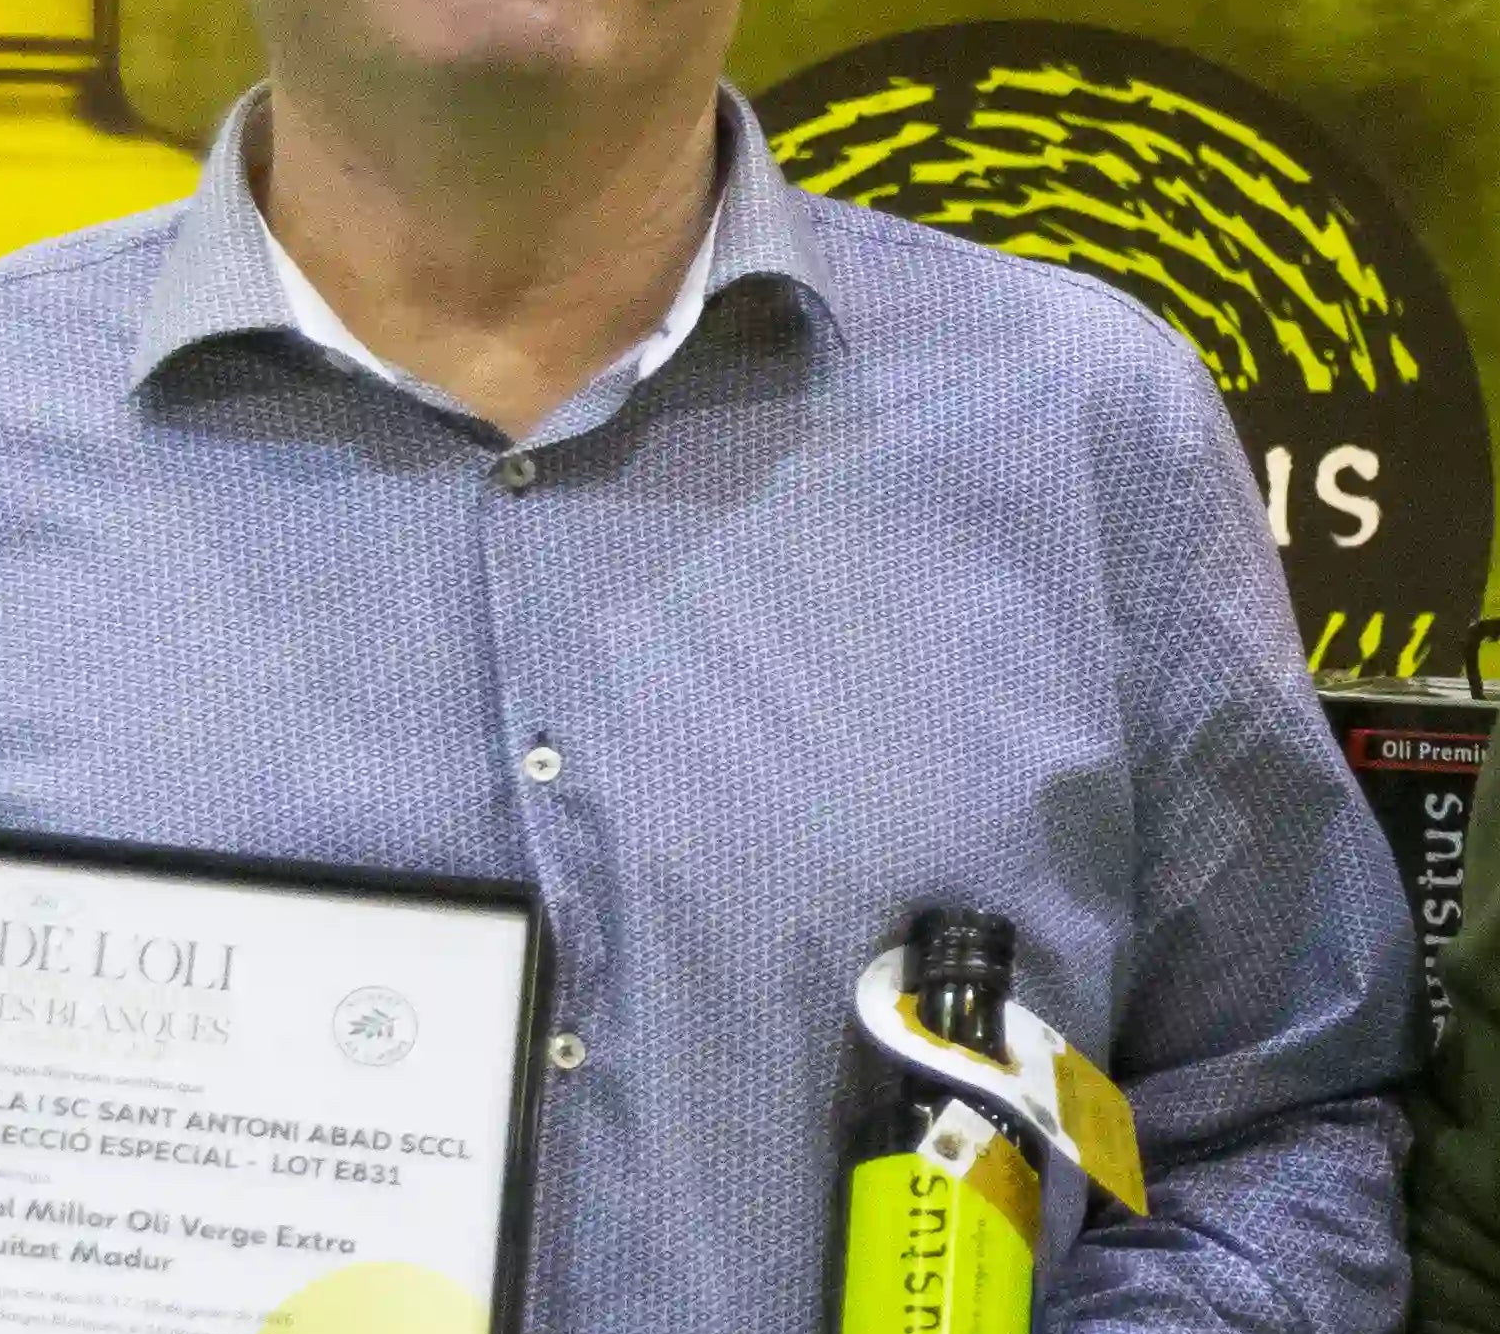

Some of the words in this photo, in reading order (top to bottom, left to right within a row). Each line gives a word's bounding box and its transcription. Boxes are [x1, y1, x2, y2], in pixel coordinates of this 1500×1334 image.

[1382, 739, 1411, 760] Oli
[91, 930, 234, 992] L'OLI
[45, 997, 231, 1049] BLANQUES
[51, 1095, 89, 1119] SC
[97, 1100, 177, 1128] SANT
[183, 1110, 299, 1142] ANTONI
[305, 1123, 392, 1151] ABAD
[398, 1132, 470, 1160] SCCL
[98, 1134, 238, 1169] ESPECIAL
[270, 1153, 326, 1178] LOT
[333, 1159, 401, 1186] E831
[23, 1198, 117, 1229] Millor
[125, 1209, 169, 1235] Oli
[179, 1214, 267, 1249] Verge
[275, 1223, 356, 1255] Extra
[68, 1240, 173, 1271] Madur
